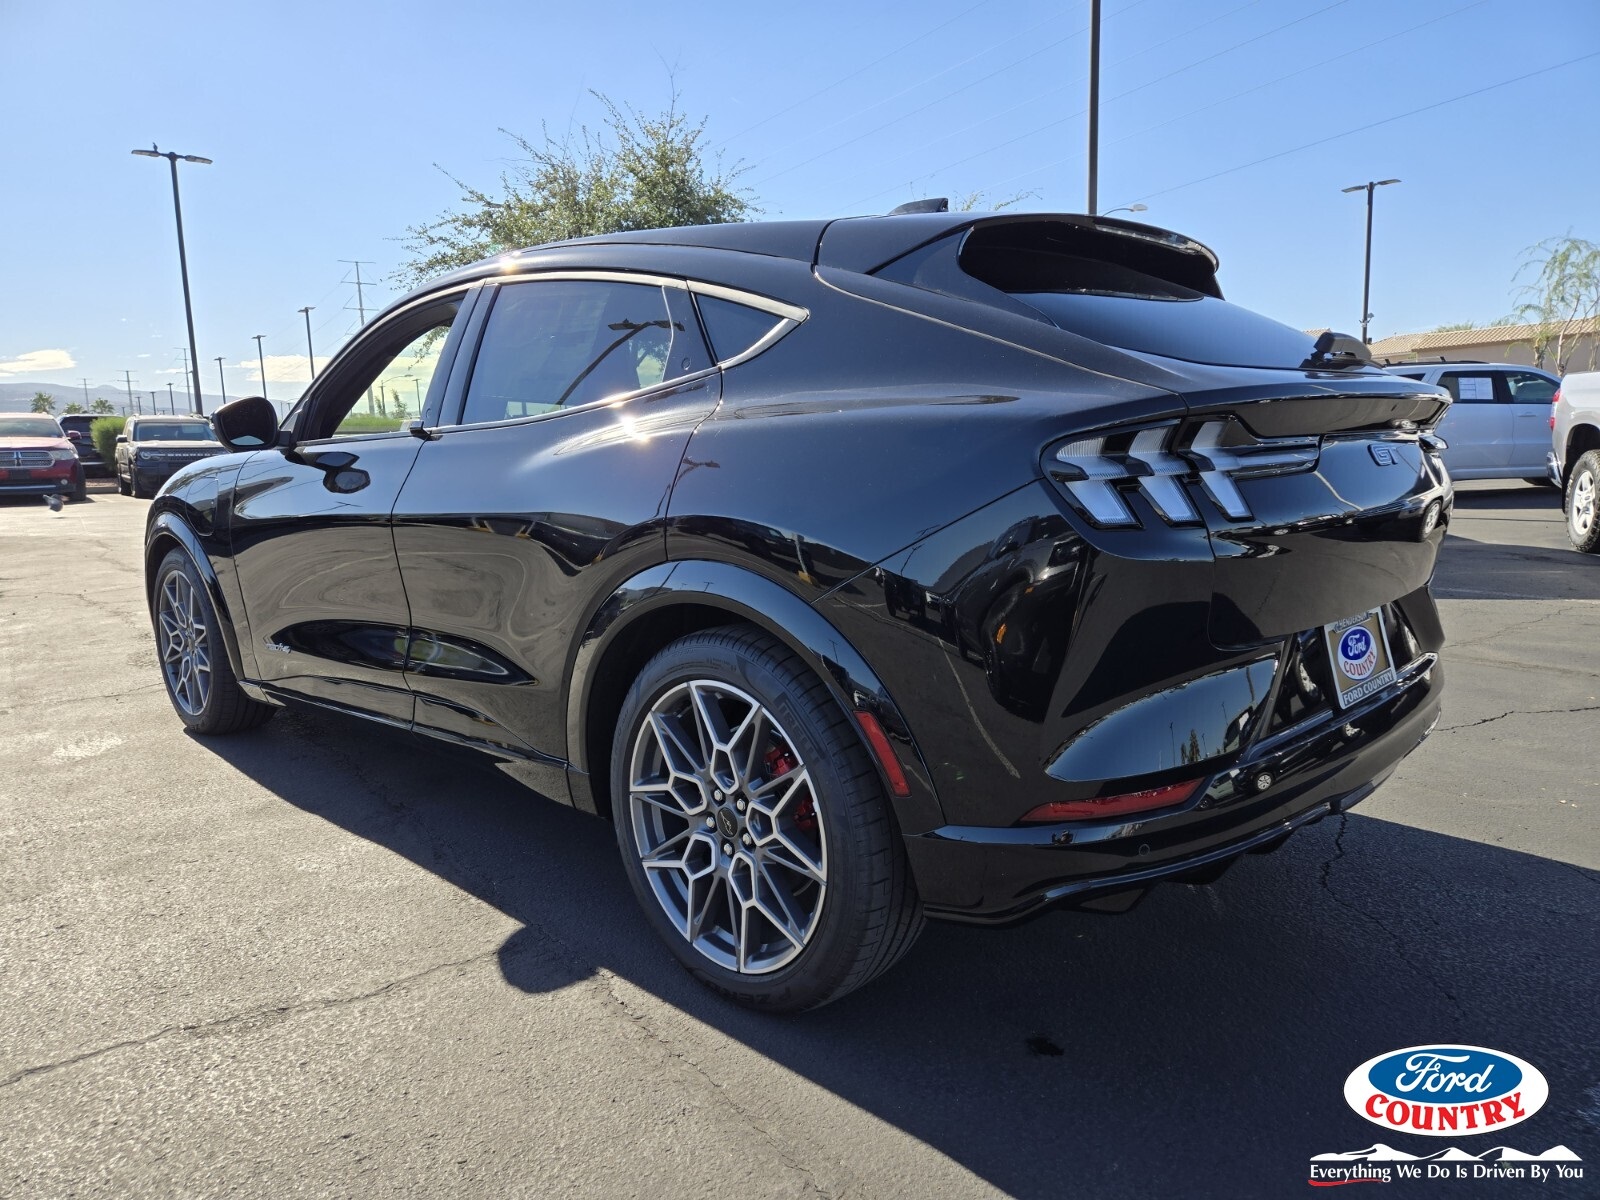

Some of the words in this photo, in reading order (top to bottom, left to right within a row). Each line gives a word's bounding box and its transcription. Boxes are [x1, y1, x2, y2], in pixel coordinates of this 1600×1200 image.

[1367, 444, 1398, 466] GT
[1347, 633, 1366, 657] Ford
[1343, 651, 1376, 676] COUNTRY
[1343, 690, 1363, 705] FORD
[1363, 671, 1393, 693] COUNTRY
